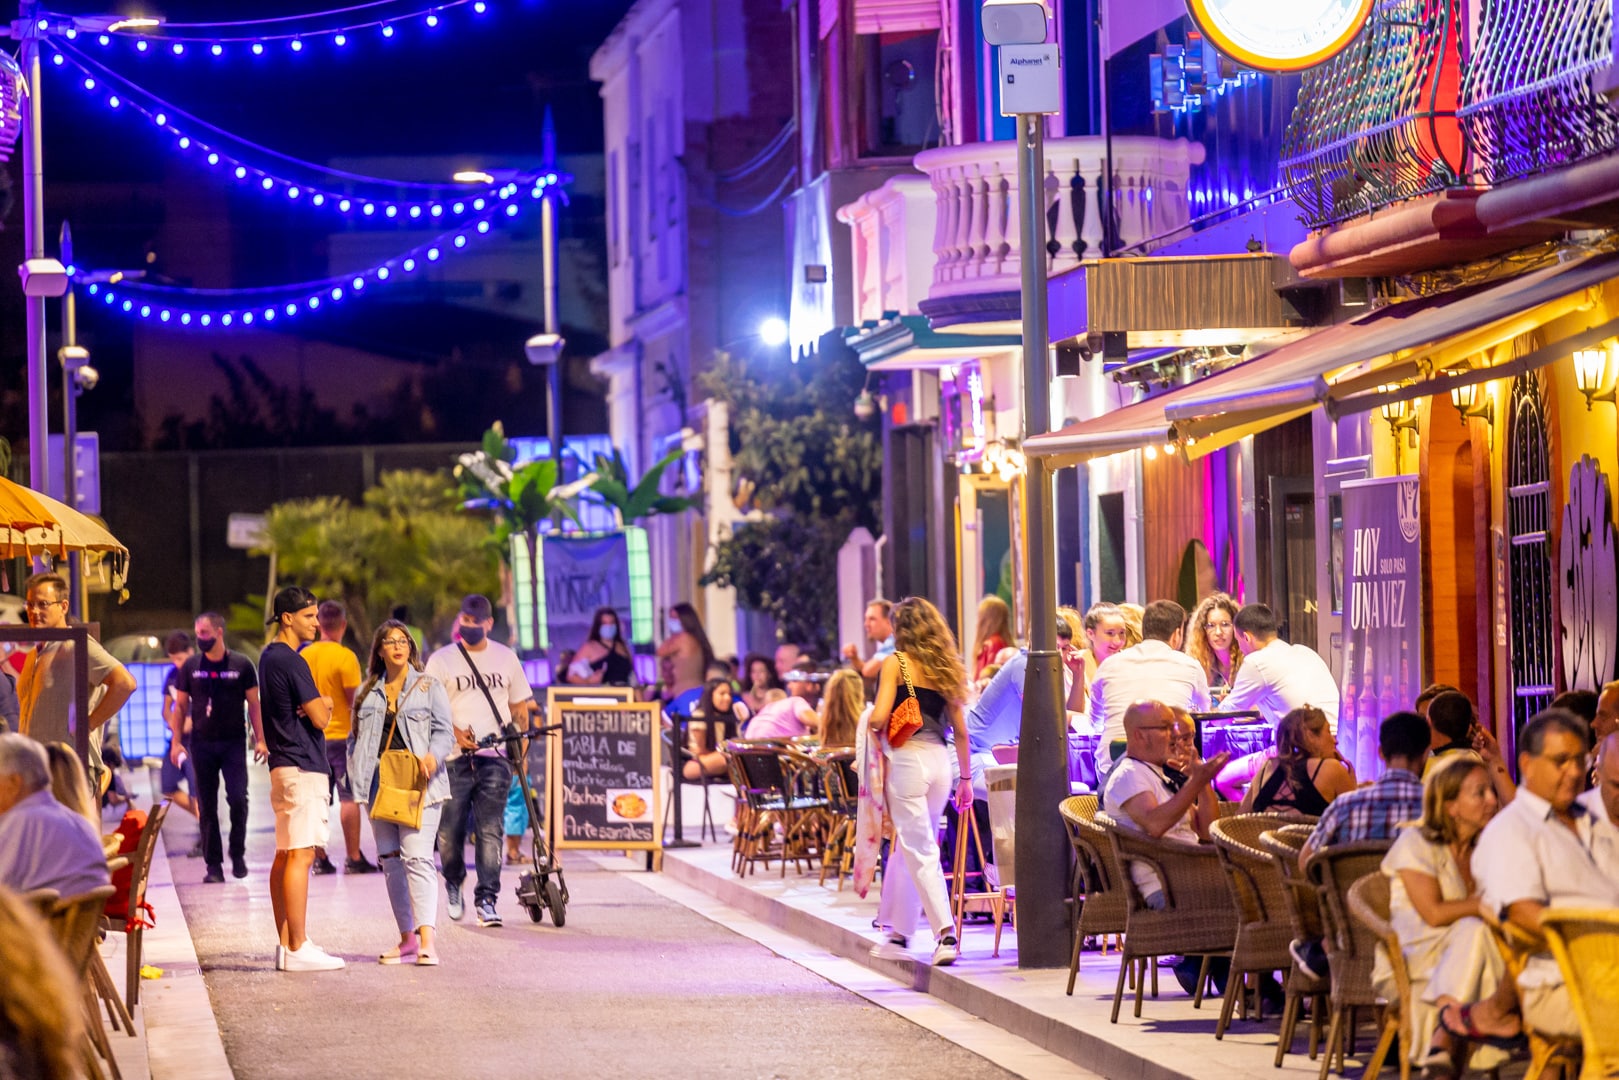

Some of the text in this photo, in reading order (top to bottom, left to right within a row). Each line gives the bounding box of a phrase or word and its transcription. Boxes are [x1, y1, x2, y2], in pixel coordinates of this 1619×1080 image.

[1010, 58, 1042, 67] Alphanet
[1352, 527, 1406, 577] HOY SOLO PASA
[1350, 579, 1406, 630] UNA VEZ
[456, 673, 503, 691] DIOR
[563, 735, 637, 756] TABLA DE
